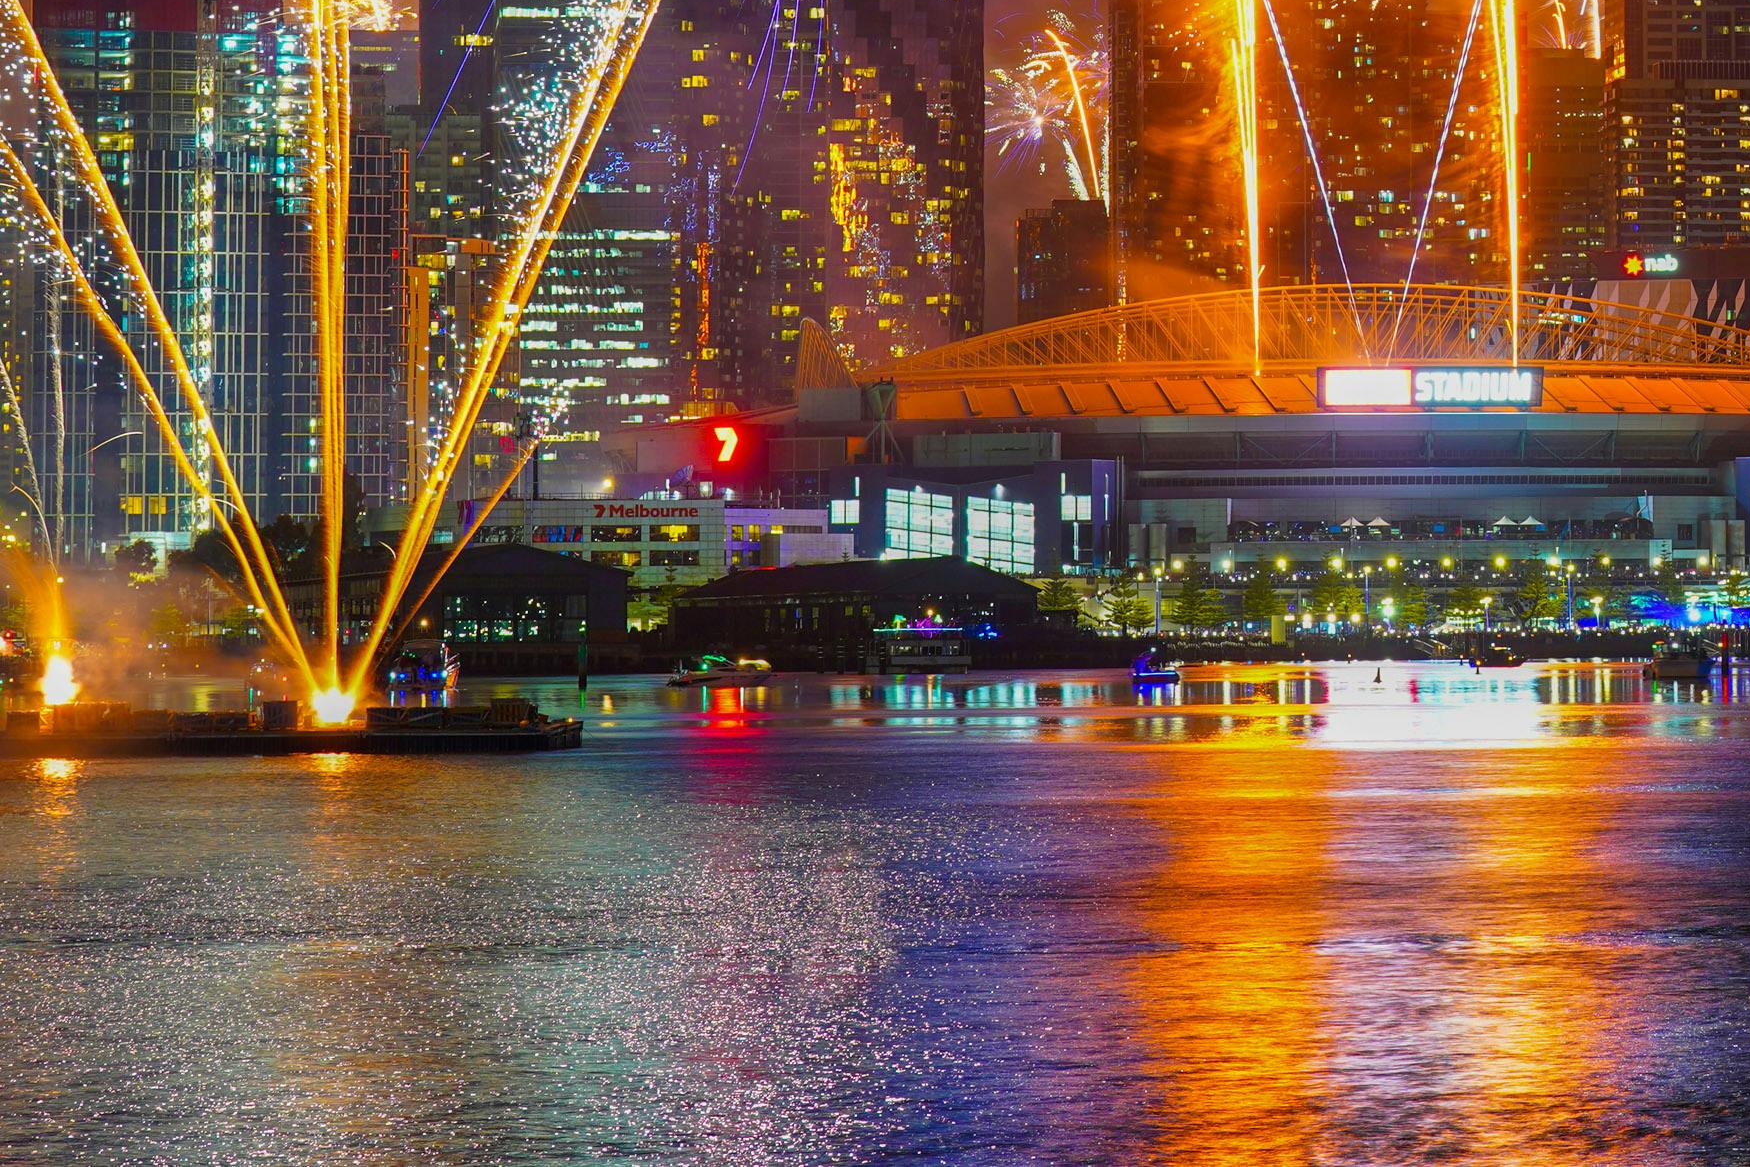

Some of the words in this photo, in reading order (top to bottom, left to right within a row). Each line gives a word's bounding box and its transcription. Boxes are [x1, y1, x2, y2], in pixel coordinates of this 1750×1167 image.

[1644, 253, 1679, 272] nab
[1414, 371, 1533, 402] STADIUM
[714, 427, 739, 462] 7
[593, 503, 606, 518] 7
[608, 503, 699, 518] Melbourne
